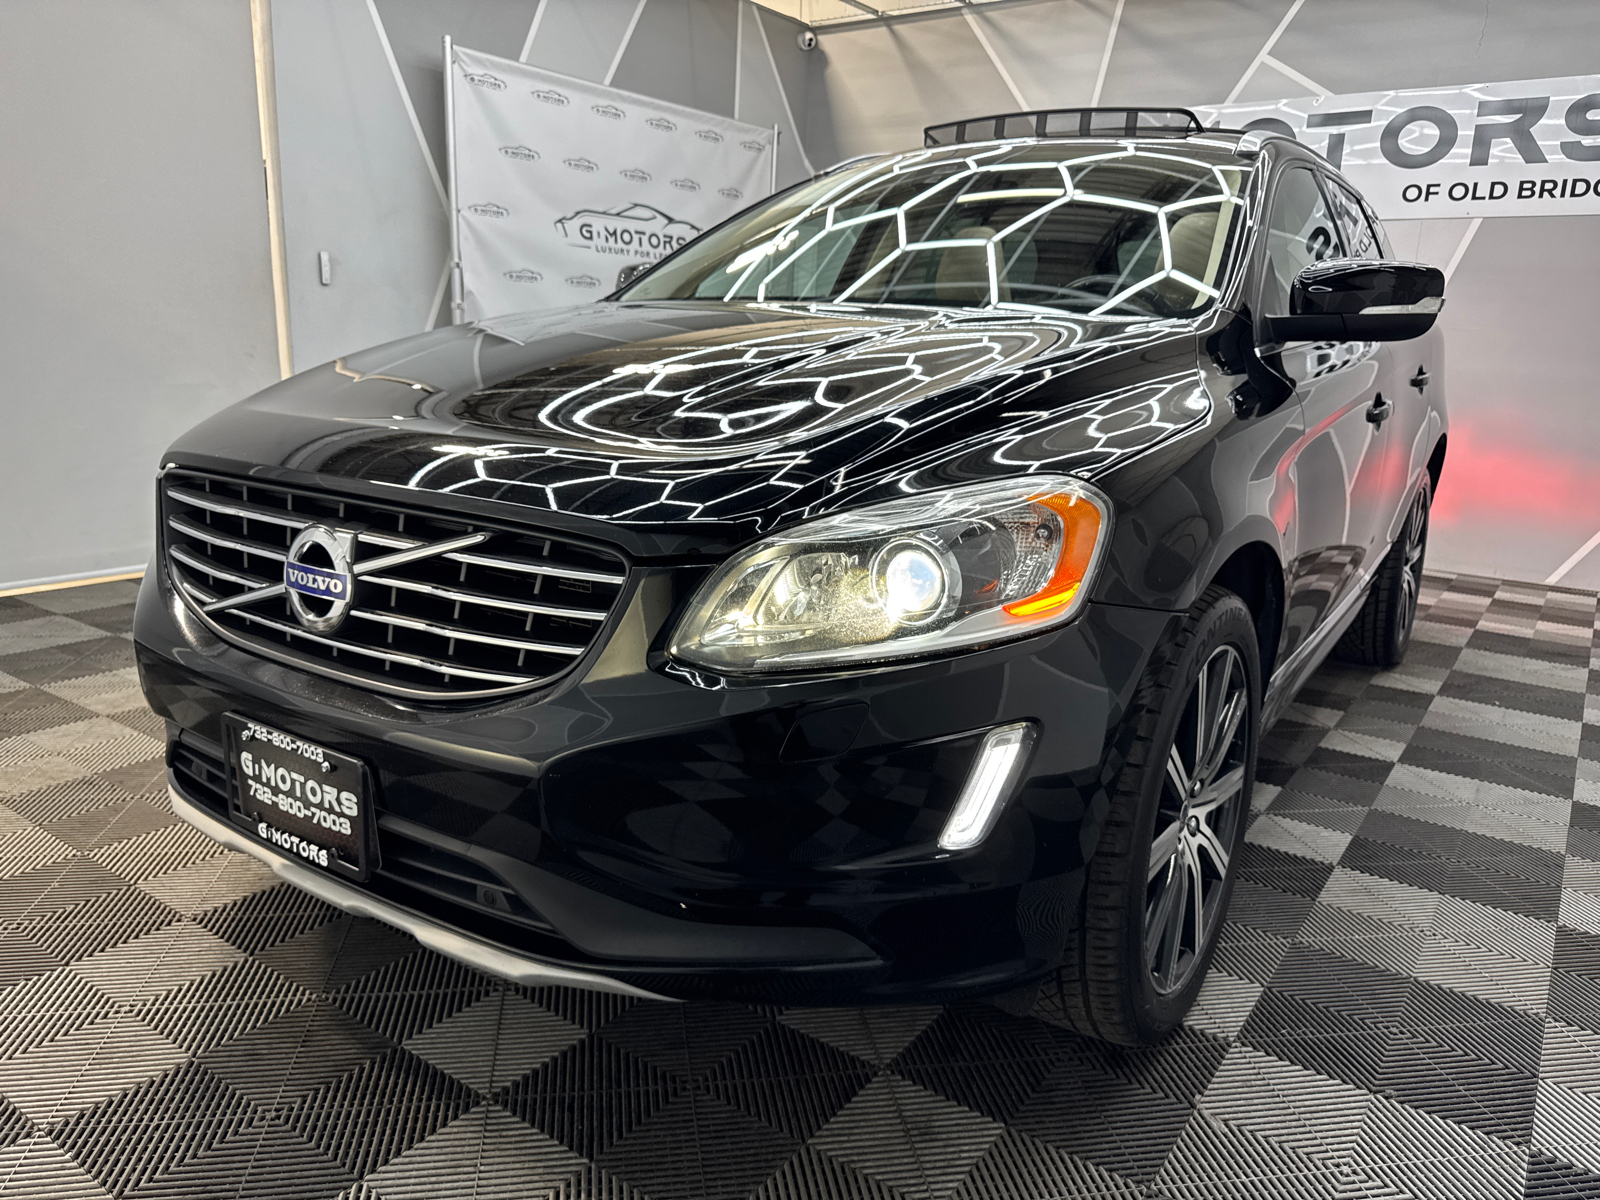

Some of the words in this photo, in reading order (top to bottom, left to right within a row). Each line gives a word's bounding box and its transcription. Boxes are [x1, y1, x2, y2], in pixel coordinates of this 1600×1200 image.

[1211, 93, 1600, 171] TORS
[1402, 183, 1441, 203] OF
[1448, 181, 1509, 201] OLD
[287, 568, 343, 593] VOLVO
[247, 723, 324, 762] 732-800-7003
[247, 779, 352, 836] 732-800-7003
